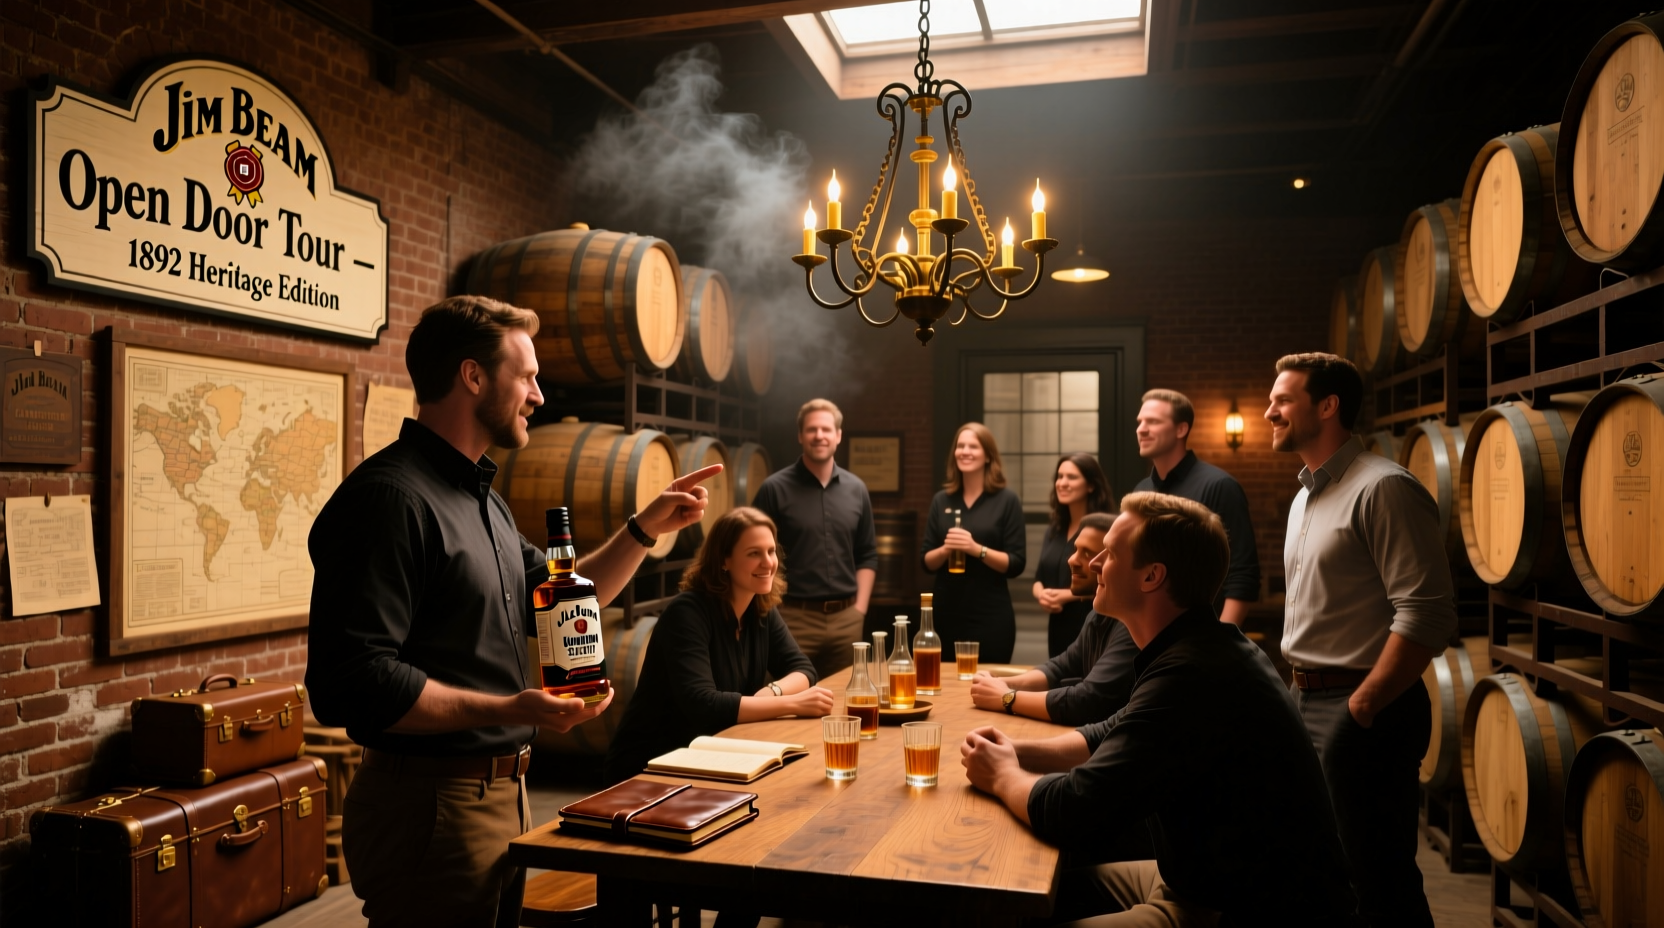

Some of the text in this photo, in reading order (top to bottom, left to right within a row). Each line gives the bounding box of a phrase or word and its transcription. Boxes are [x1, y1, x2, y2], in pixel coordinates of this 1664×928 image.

[230, 86, 319, 200] BEAM
[58, 148, 171, 231] Open
[182, 177, 269, 249] Door
[278, 208, 346, 272] Tour
[128, 238, 340, 311] 1892 Heritage Edition
